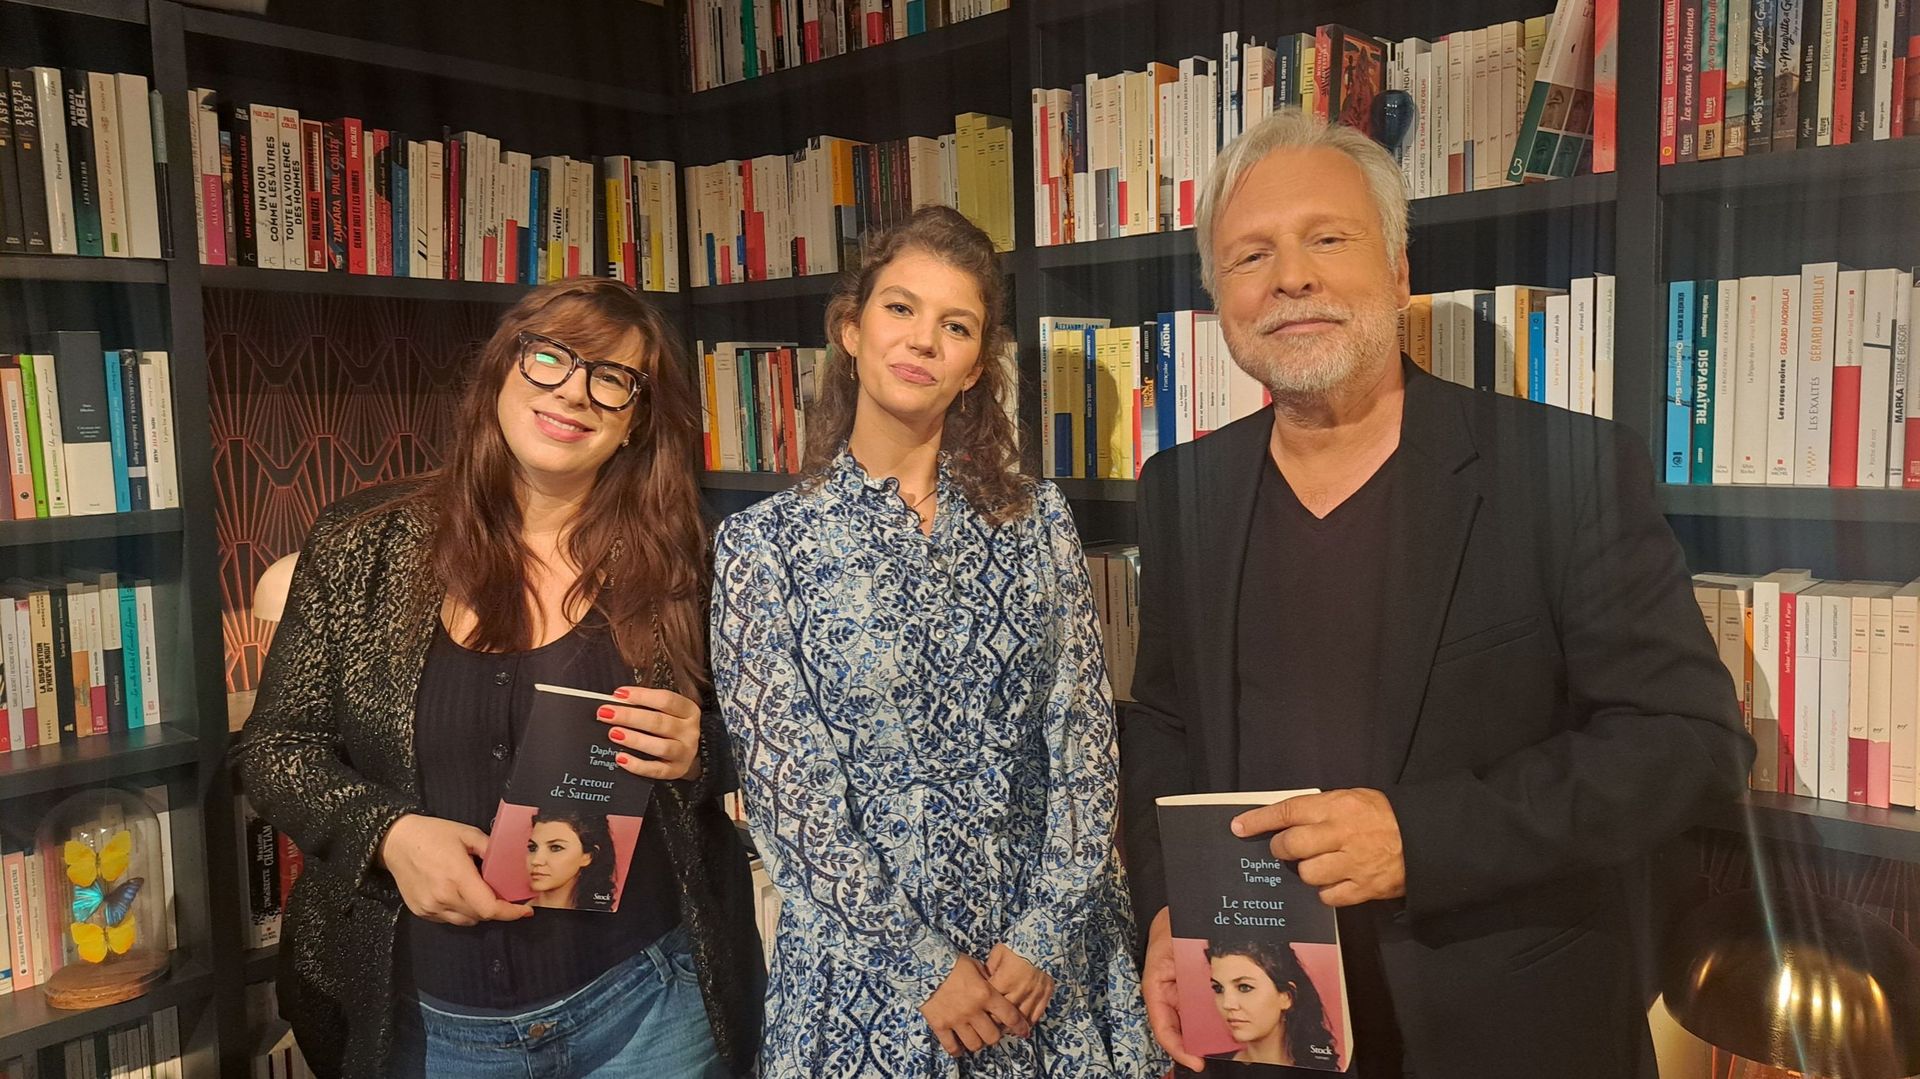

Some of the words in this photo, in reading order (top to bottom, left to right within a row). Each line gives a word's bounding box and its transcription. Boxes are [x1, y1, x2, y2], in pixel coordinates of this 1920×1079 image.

[1666, 27, 1675, 39] LES
[1683, 7, 1695, 61] châtiments
[1666, 41, 1674, 59] DANS
[1665, 60, 1674, 85] CRIMES
[12, 81, 24, 125] PIETER
[1684, 74, 1692, 105] cream
[23, 95, 35, 126] ASPE
[69, 88, 77, 126] BARBARA
[76, 89, 88, 128] ABEL
[1680, 107, 1691, 121] Ice
[266, 136, 276, 177] AUTRES
[282, 142, 292, 192] VIOLENCE
[330, 138, 340, 170] COLIZE
[257, 166, 267, 193] JOUR
[268, 180, 277, 198] LES
[292, 160, 301, 204] HOMMES
[332, 173, 341, 195] PAUL
[258, 194, 268, 211] UN
[285, 194, 292, 207] LA
[270, 203, 279, 242] COMME
[285, 209, 294, 241] TOUTE
[294, 206, 302, 225] DES
[333, 200, 342, 242] ZANZARA
[1781, 288, 1790, 326] MORDILLAT
[1811, 274, 1825, 324] MORDILLAT
[1162, 323, 1171, 359] JARDIN
[1778, 327, 1789, 355] GÉRARD
[1808, 326, 1823, 362] GÉRARD
[1898, 324, 1908, 355] BONSOIR
[1778, 359, 1787, 384] noires
[1895, 357, 1906, 386] TERMINÉ
[1696, 350, 1710, 425] DISPARAÎTRE
[1808, 376, 1821, 414] EXALTÉS
[1777, 407, 1785, 420] Les
[1894, 388, 1905, 423] MARKA
[1808, 415, 1819, 431] LES
[36, 642, 46, 684] DISPARITION
[43, 642, 51, 664] SNOUT
[39, 685, 46, 694] LA
[590, 745, 619, 757] Daphn
[550, 786, 565, 798] de
[568, 788, 611, 802] Saturne
[562, 773, 577, 785] Le
[579, 777, 615, 790] retour
[262, 825, 274, 866] CHATTAM
[1240, 858, 1281, 872] Daphné
[1243, 872, 1282, 887] Tamage
[592, 892, 611, 901] Stock
[1221, 895, 1240, 910] Le
[1243, 897, 1284, 911] retour
[1214, 912, 1230, 925] de
[1233, 912, 1286, 928] Saturne
[1309, 1045, 1332, 1055] Stock
